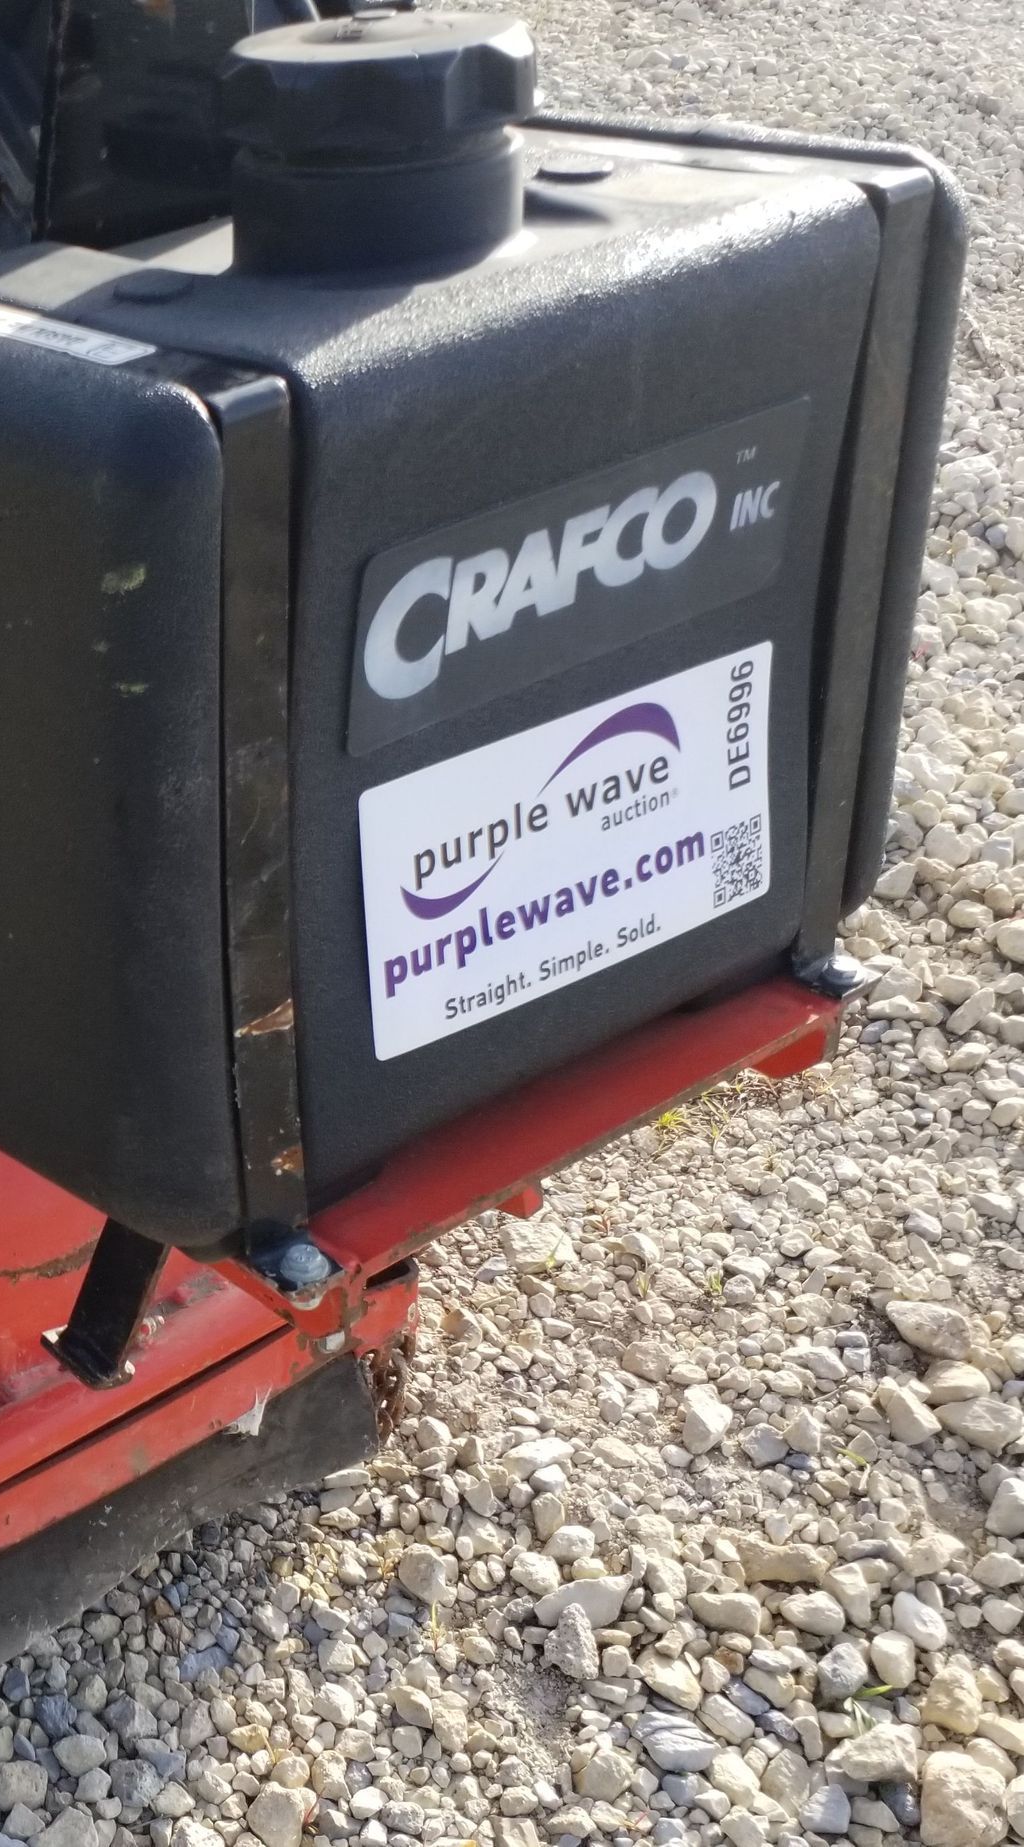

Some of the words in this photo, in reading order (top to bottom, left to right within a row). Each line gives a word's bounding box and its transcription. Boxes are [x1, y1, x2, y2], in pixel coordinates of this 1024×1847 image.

[364, 471, 717, 700] CRAFCO
[730, 481, 780, 531] INC
[726, 660, 754, 791] DE6996
[413, 803, 548, 890] purple
[565, 755, 670, 818] wave
[601, 793, 670, 831] auction
[384, 831, 705, 998] purplewave.com
[444, 977, 532, 1019] Straight.
[539, 941, 610, 984] Simple.
[617, 914, 661, 948] Sold.
